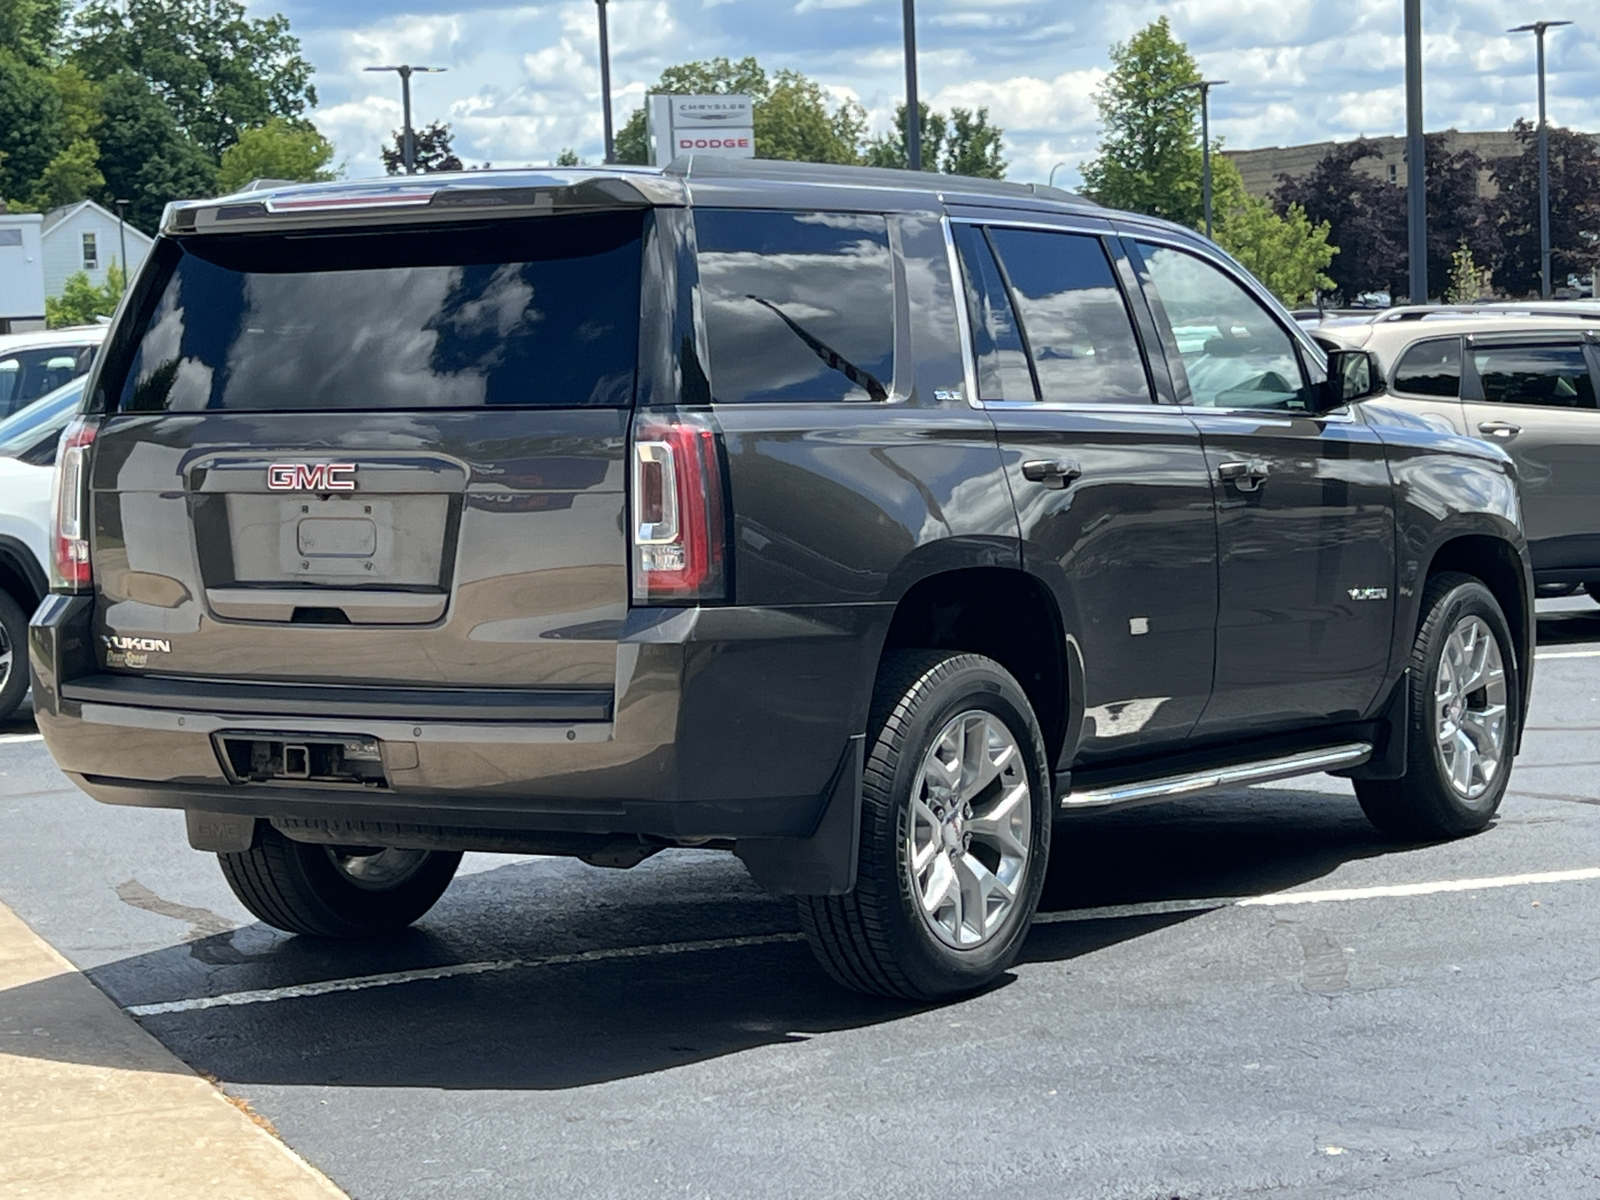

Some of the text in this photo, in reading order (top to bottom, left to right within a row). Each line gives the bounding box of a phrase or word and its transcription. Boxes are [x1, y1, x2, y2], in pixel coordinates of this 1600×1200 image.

[679, 103, 746, 111] CHRYSLER
[680, 139, 749, 149] DODGE
[268, 463, 355, 490] GMC
[101, 635, 171, 652] YUKON
